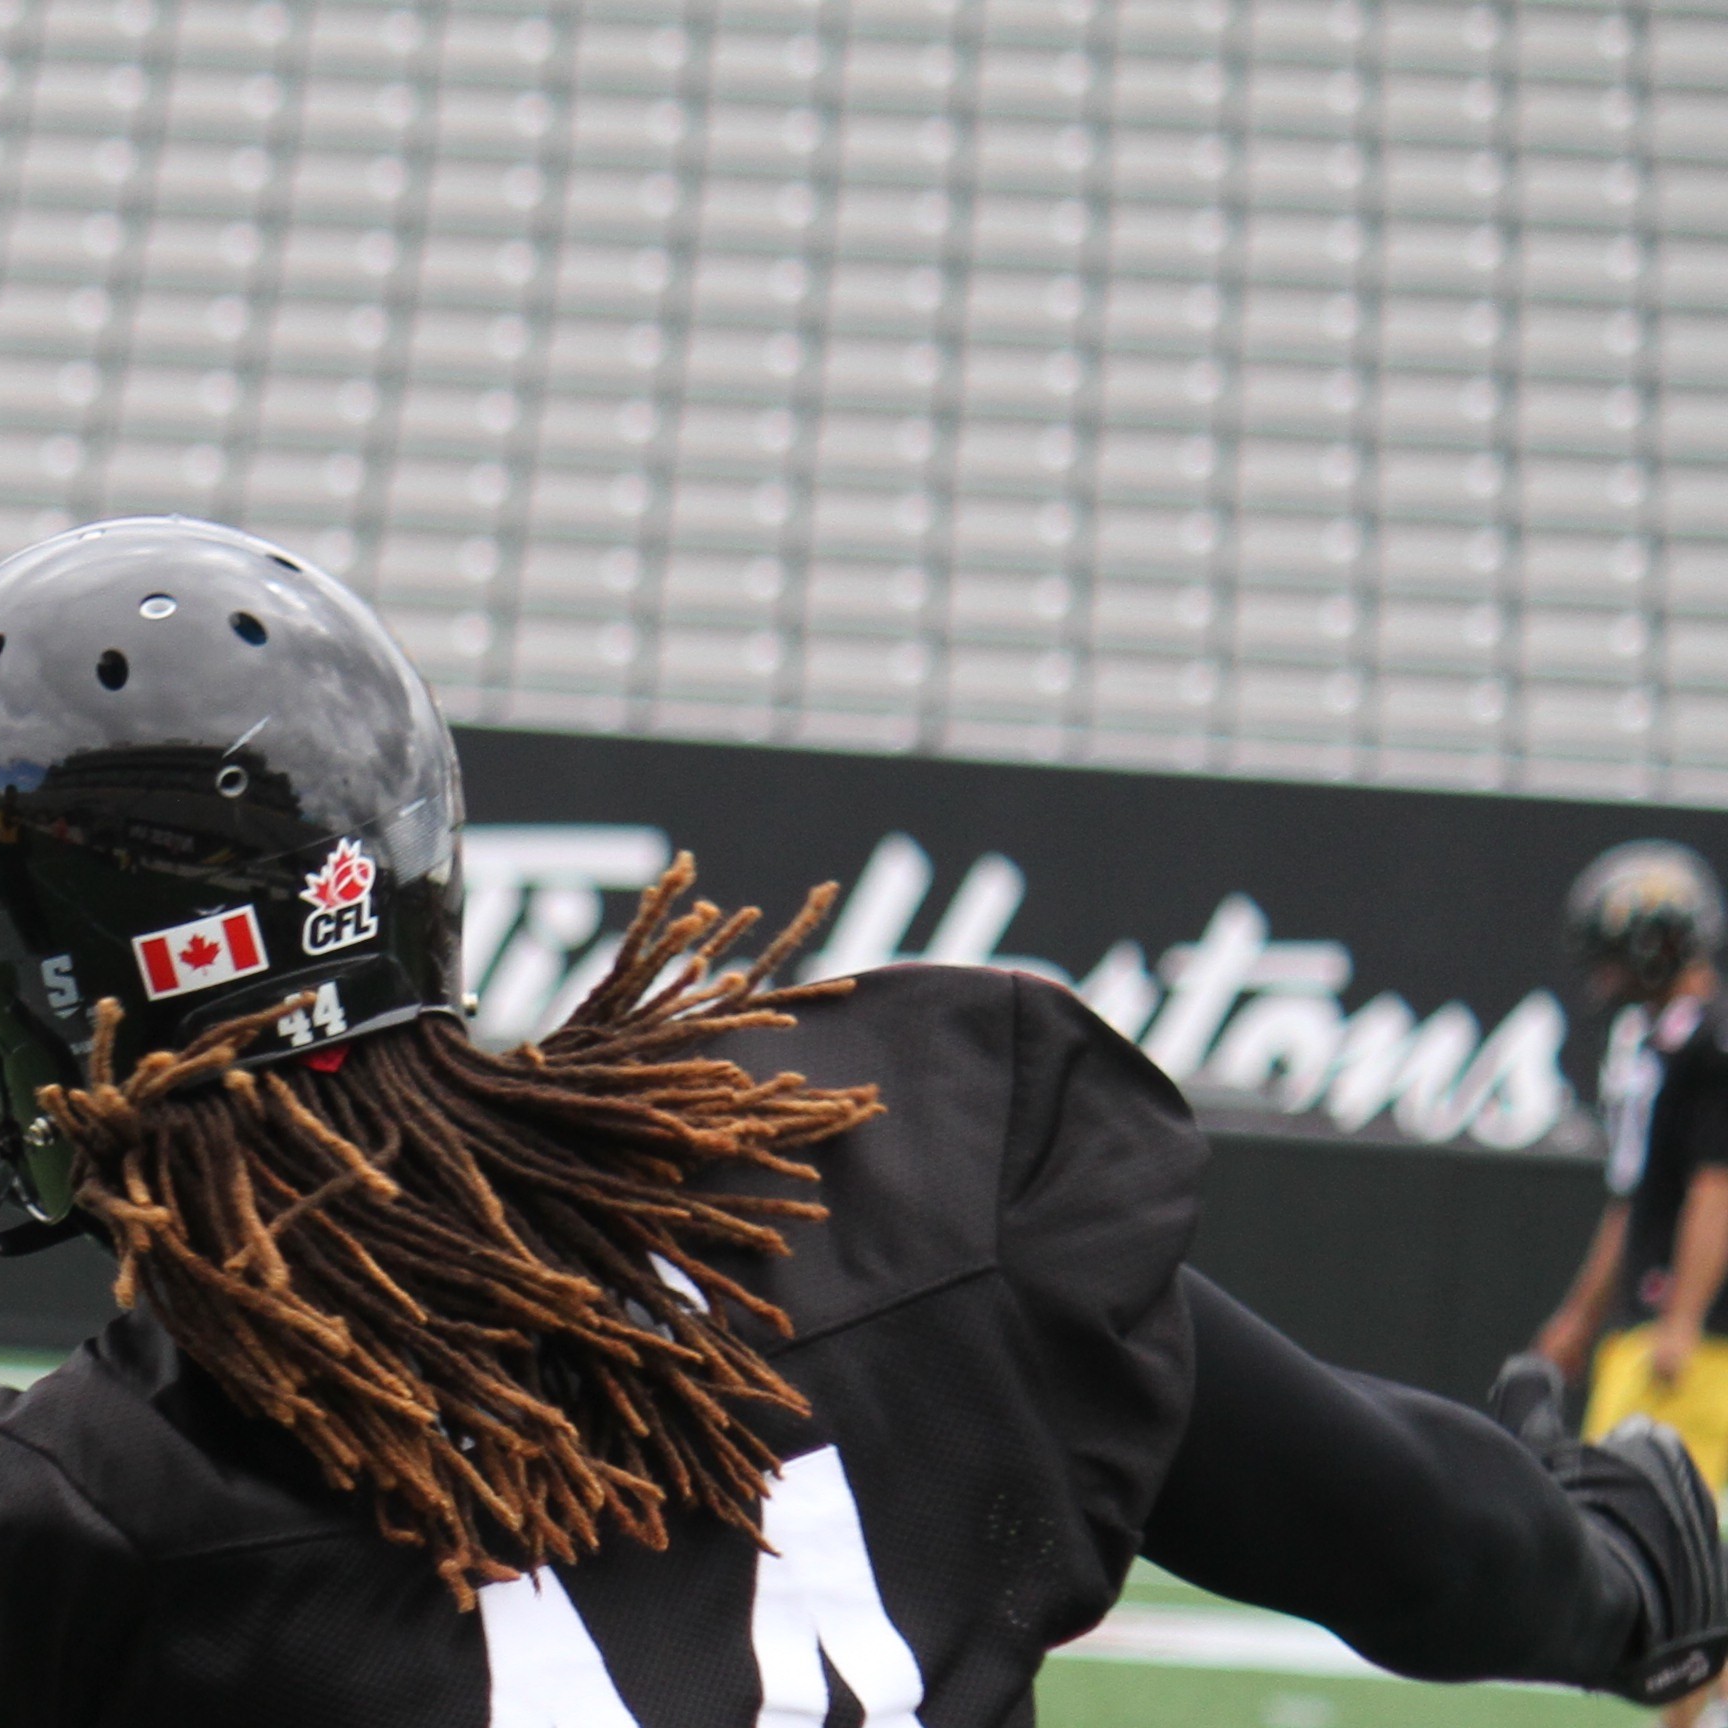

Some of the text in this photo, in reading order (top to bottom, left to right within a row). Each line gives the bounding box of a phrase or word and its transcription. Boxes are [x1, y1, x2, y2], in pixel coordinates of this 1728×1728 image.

[305, 899, 376, 953] CFL
[277, 981, 348, 1047] 44
[800, 830, 1566, 1150] Hrtons
